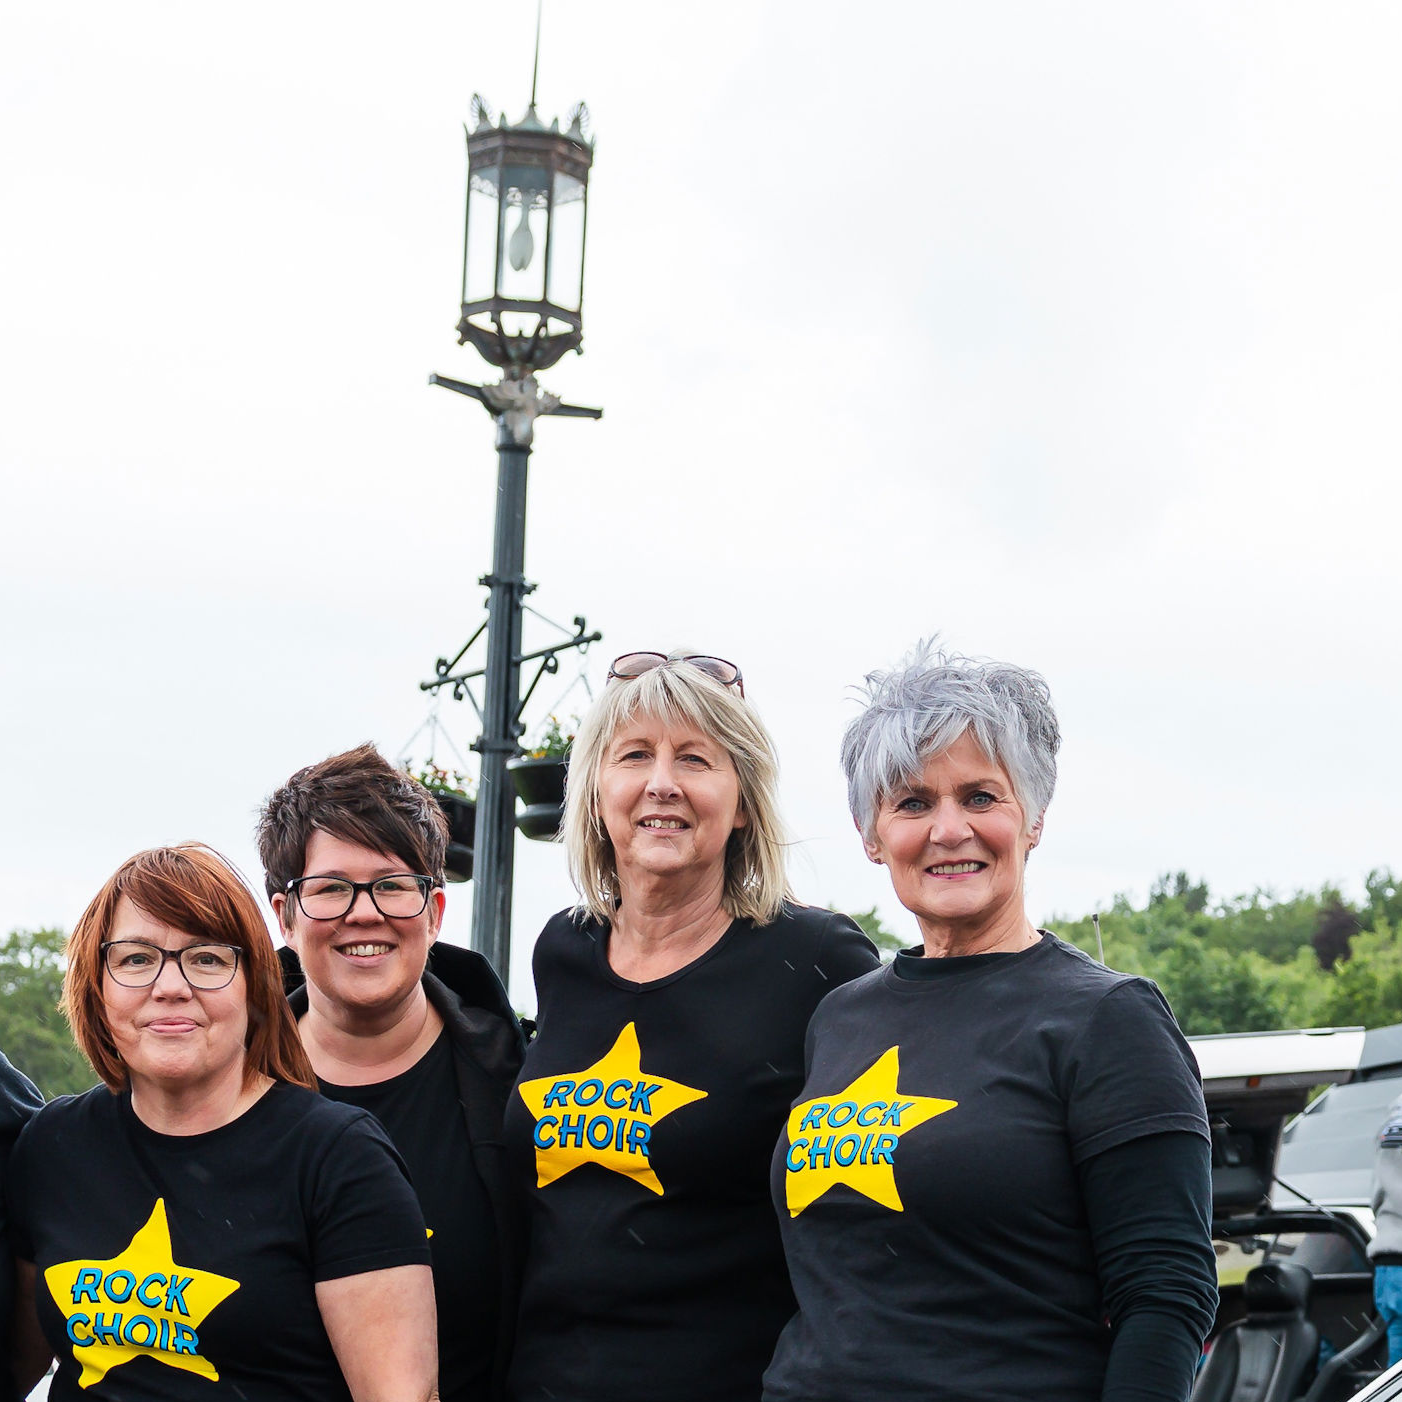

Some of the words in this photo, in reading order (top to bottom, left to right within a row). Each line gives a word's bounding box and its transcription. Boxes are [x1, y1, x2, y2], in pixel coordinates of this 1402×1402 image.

[543, 1079, 663, 1115] ROCK
[799, 1101, 916, 1132] ROCK
[533, 1114, 652, 1157] CHOIR
[785, 1133, 899, 1173] CHOIR
[70, 1267, 194, 1317] ROCK
[66, 1312, 199, 1355] CHOIR
